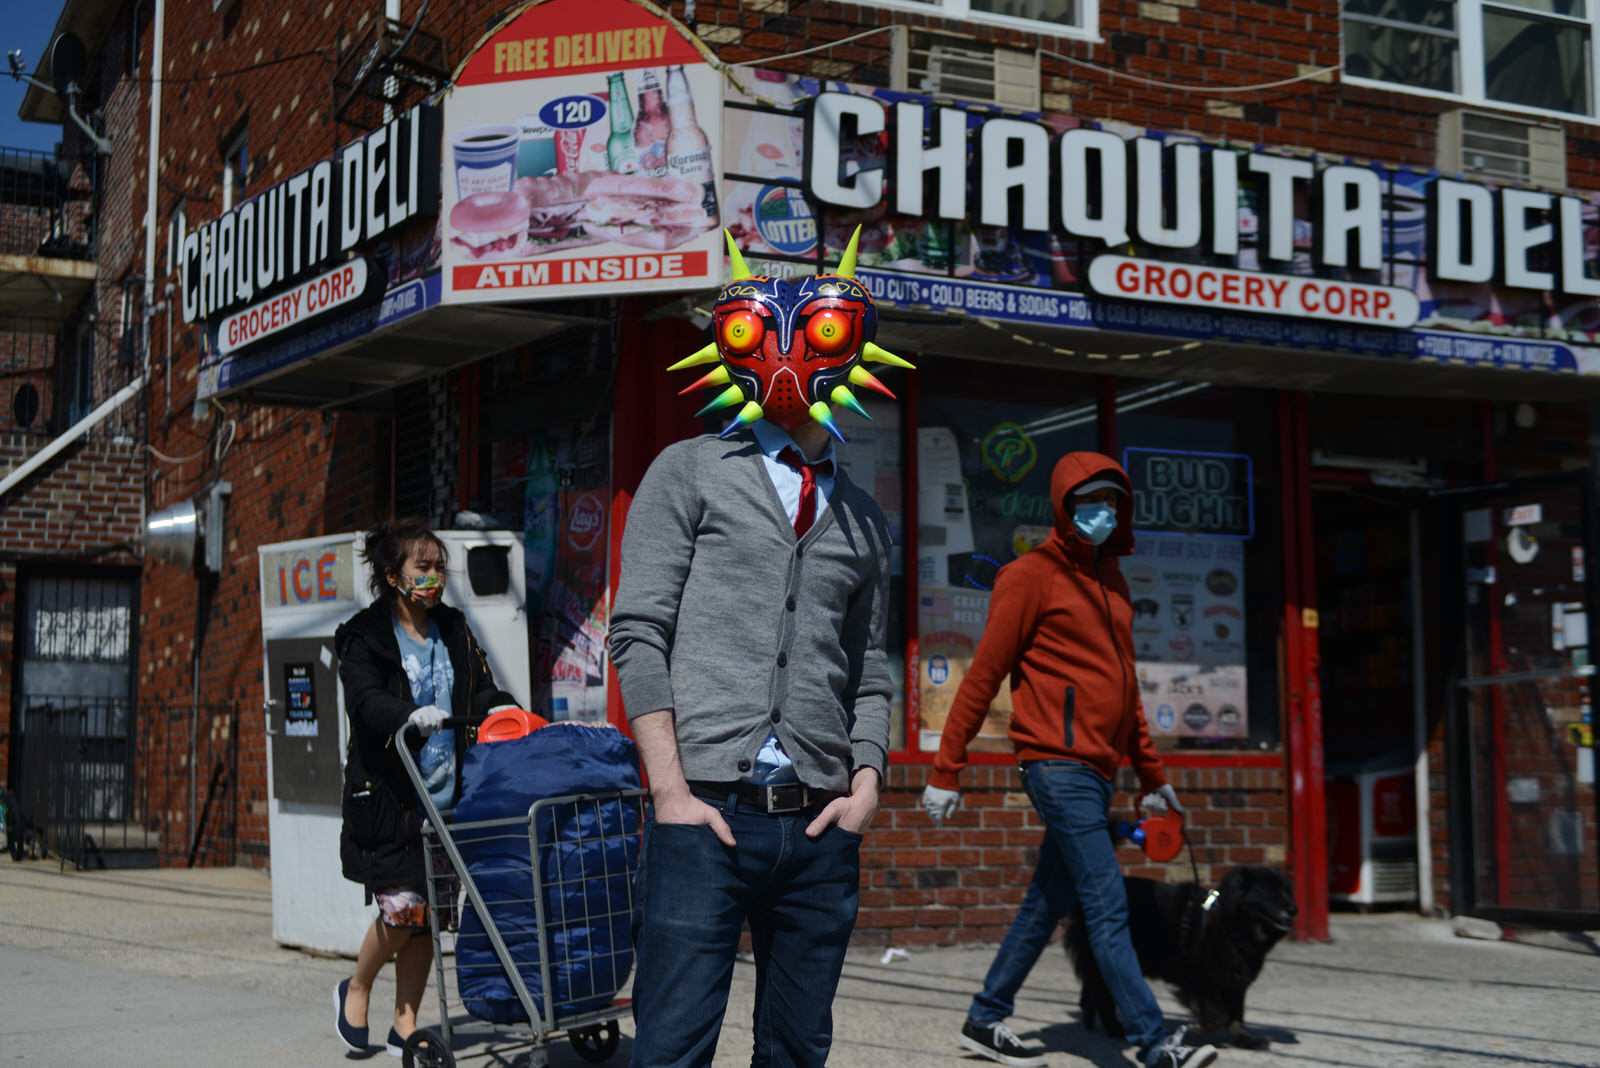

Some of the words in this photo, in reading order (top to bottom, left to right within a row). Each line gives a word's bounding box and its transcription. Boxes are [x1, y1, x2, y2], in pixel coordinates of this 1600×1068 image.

[494, 37, 549, 74] FREE
[554, 25, 668, 68] DELIVERY
[553, 99, 592, 125] 120
[669, 151, 711, 168] Corona
[182, 160, 332, 324] CHAQUITA
[341, 104, 420, 251] DELI
[809, 91, 1382, 271] CHAQUITA
[1436, 178, 1600, 296] DEL
[761, 218, 817, 244] LOTTER
[475, 261, 549, 289] ATM
[562, 254, 684, 283] INSIDE
[1117, 262, 1289, 308] GROCERY
[1300, 282, 1396, 321] CORP.
[229, 290, 303, 346] GROCERY
[307, 266, 356, 313] CORP.
[887, 278, 920, 302] CUTS
[930, 284, 963, 306] COLD
[966, 287, 1005, 313] BEERS
[1006, 294, 1017, 311] &
[1019, 294, 1059, 319] SODAS
[1069, 298, 1092, 319] HOT
[1107, 304, 1137, 324] COLD
[1139, 308, 1213, 333] SANDWICHES
[1424, 335, 1452, 355] FOOD
[1454, 338, 1494, 361] STAMPS
[1146, 456, 1230, 493] BUD
[1133, 491, 1248, 530] LIGHT
[279, 552, 338, 606] ICE
